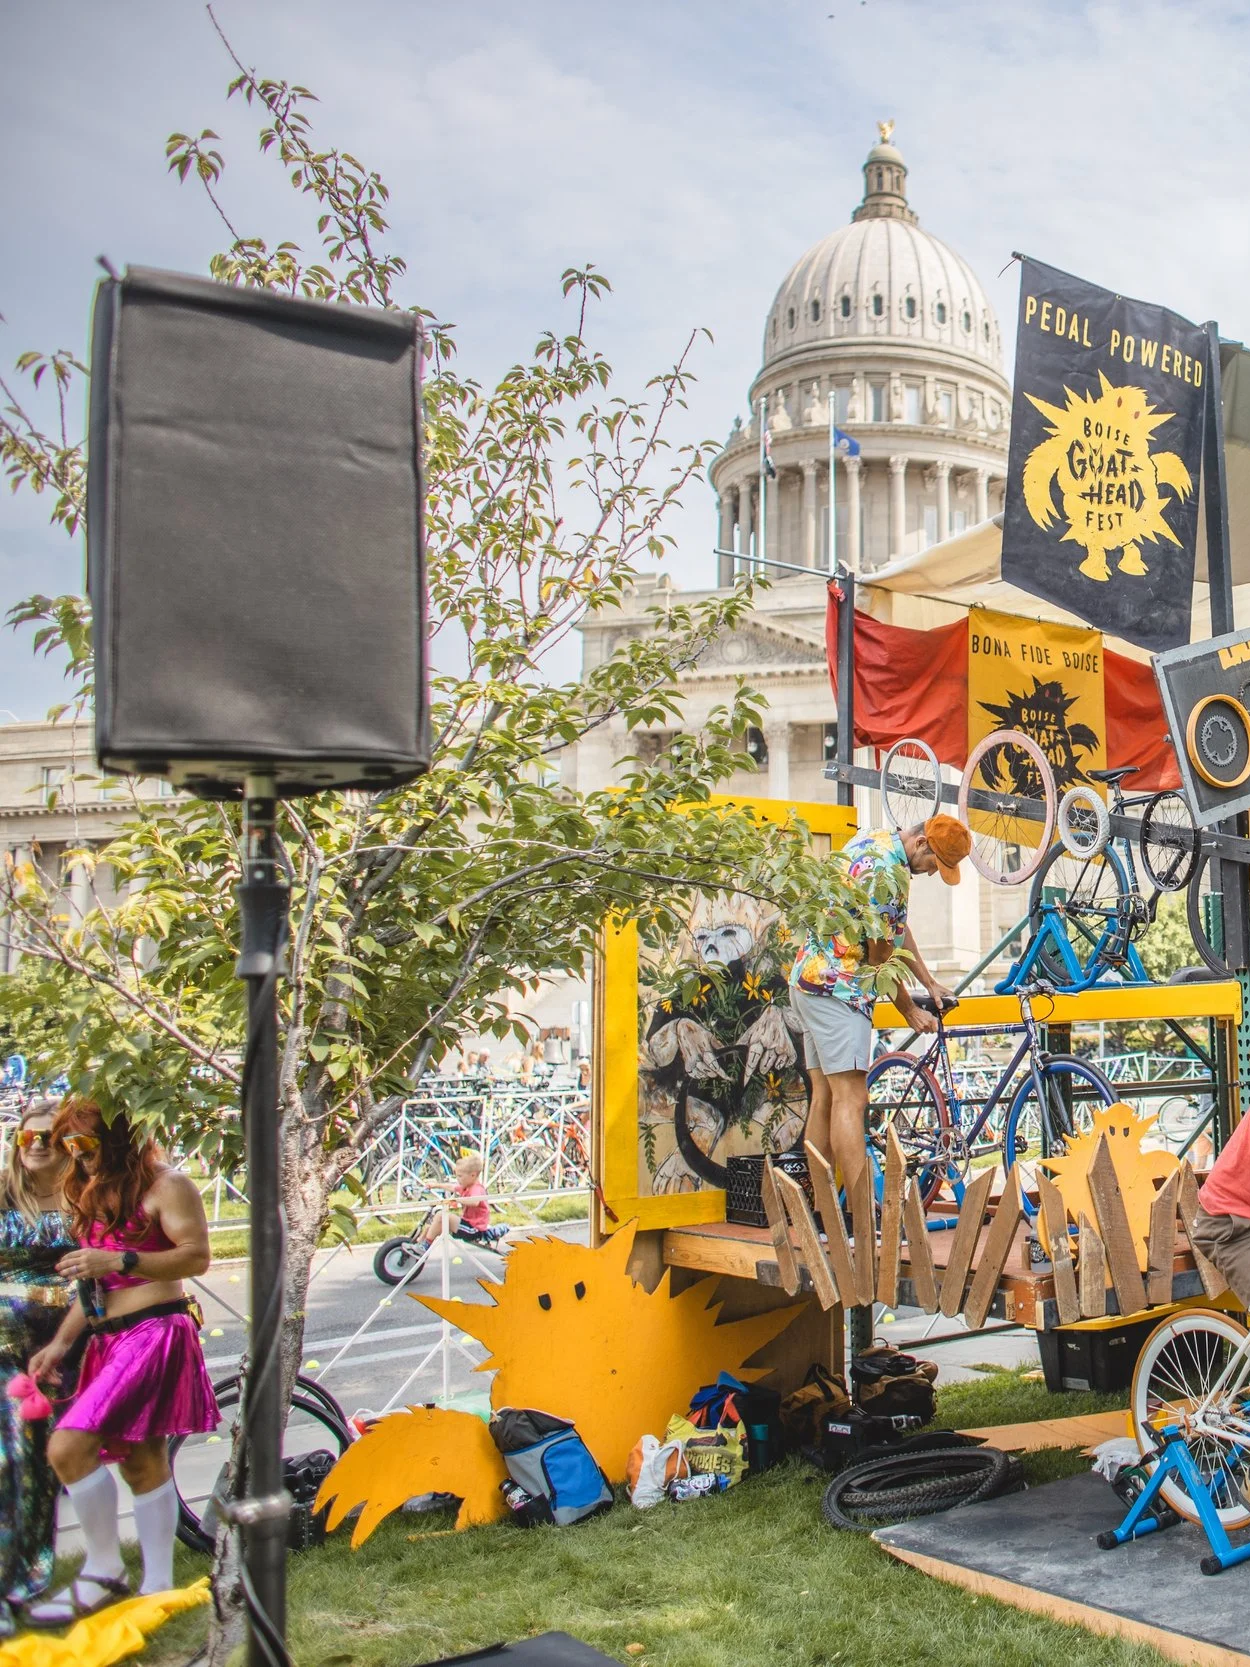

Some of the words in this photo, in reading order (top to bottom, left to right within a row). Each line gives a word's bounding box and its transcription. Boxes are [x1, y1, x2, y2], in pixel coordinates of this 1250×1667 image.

[1025, 295, 1092, 348] PEDAL
[1110, 329, 1203, 388] POWERED
[1083, 416, 1130, 446] BOISE
[1066, 438, 1135, 481] GOAT
[1077, 478, 1147, 513] HEAD
[1085, 510, 1123, 531] FEST
[971, 634, 1011, 658] BONA
[1021, 643, 1053, 666] FIDE
[1062, 651, 1099, 674] BOISE
[1021, 707, 1056, 723] BOISE
